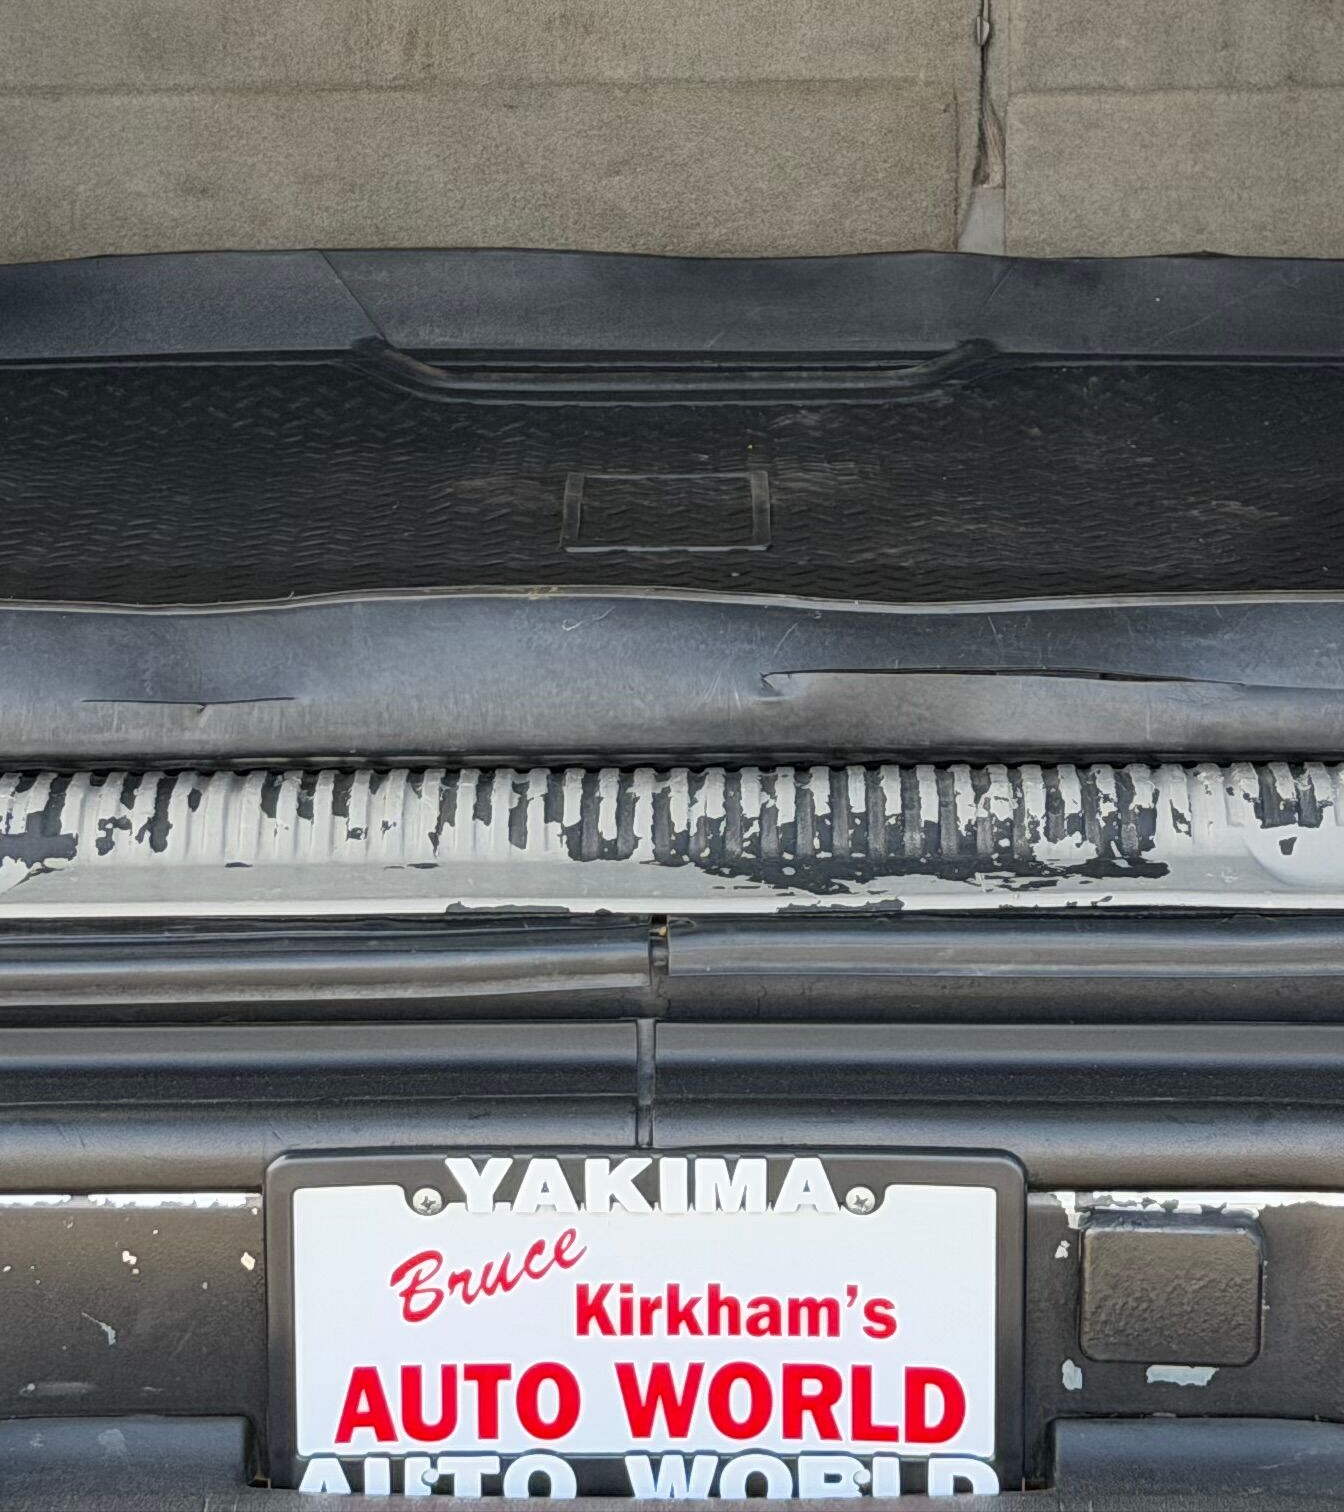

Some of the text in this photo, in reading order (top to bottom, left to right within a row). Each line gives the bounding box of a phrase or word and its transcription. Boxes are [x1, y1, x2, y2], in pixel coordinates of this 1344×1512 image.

[445, 1157, 842, 1214] YAKIMA
[389, 1228, 587, 1324] Bruce
[574, 1282, 898, 1341] Kirkham's
[334, 1360, 968, 1446] AUTO WORLD
